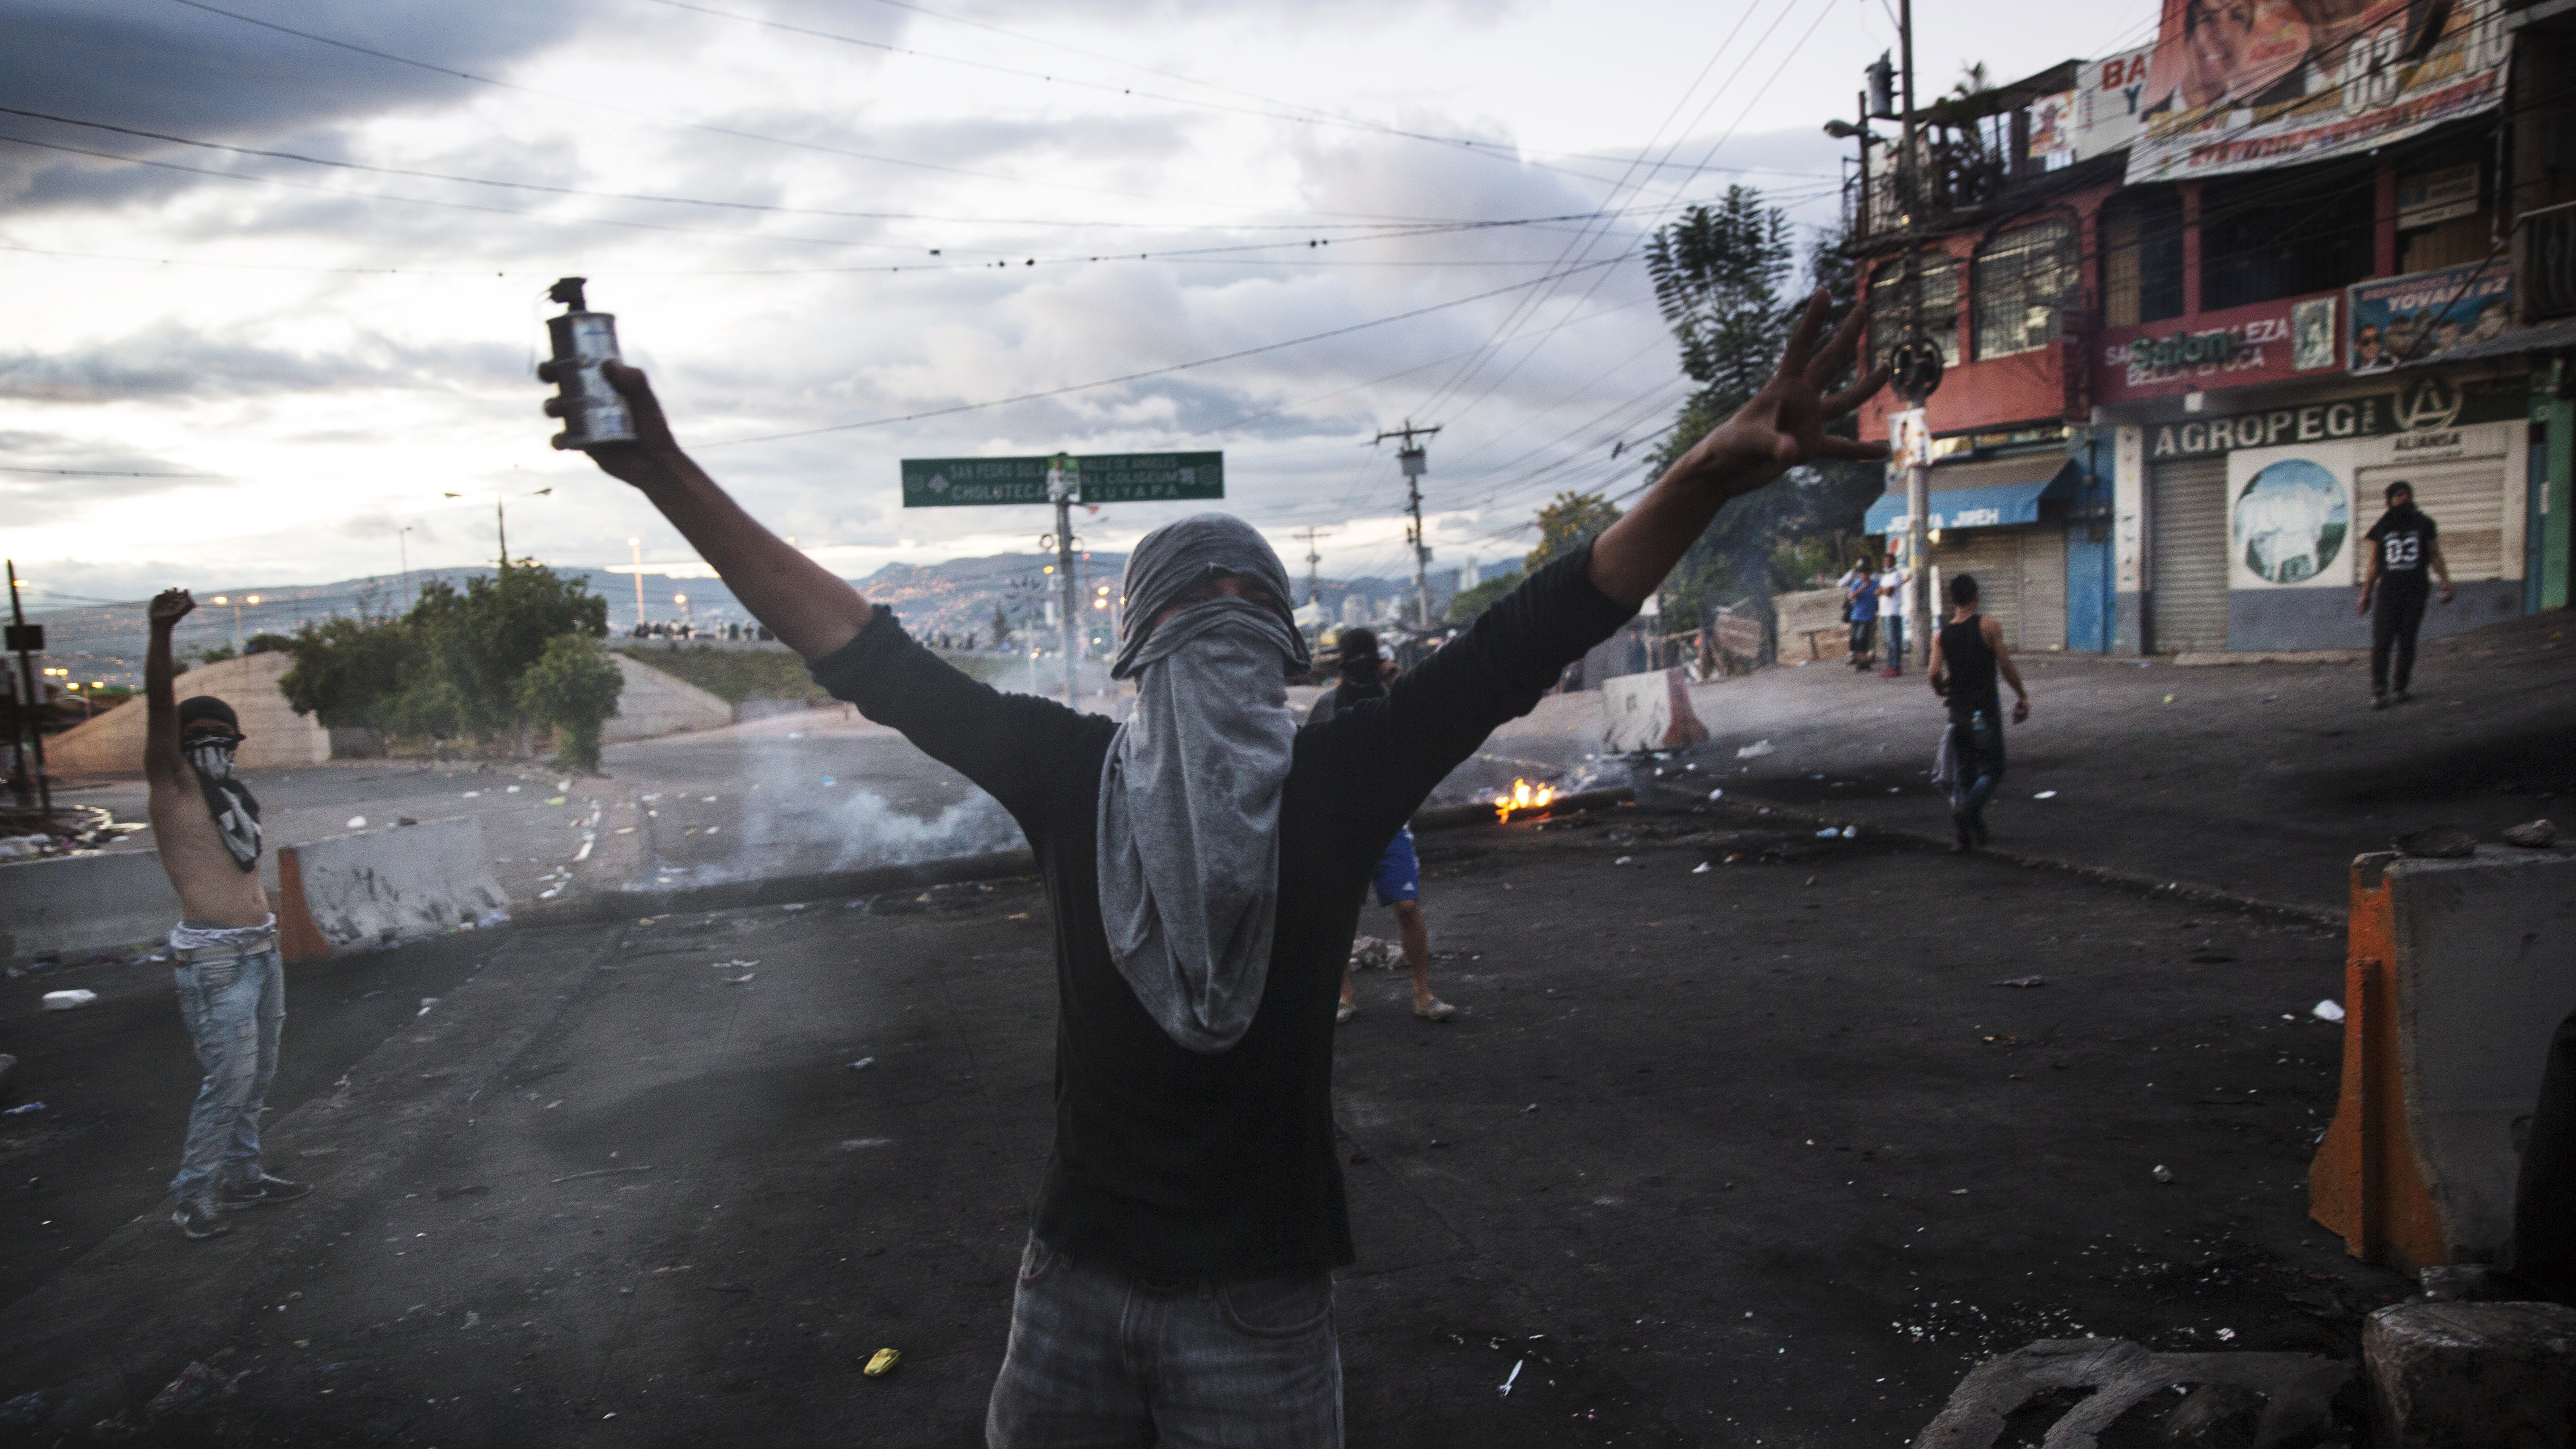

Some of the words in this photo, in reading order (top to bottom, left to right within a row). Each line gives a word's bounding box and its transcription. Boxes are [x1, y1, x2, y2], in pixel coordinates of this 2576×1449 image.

[2123, 84, 2143, 115] Y
[2153, 403, 2357, 457] AGROPEG
[950, 463, 973, 480] SAN
[976, 462, 1013, 478] PEDRO
[952, 483, 1046, 501] CHOLUTECA
[1089, 484, 1178, 498] SUYAPA
